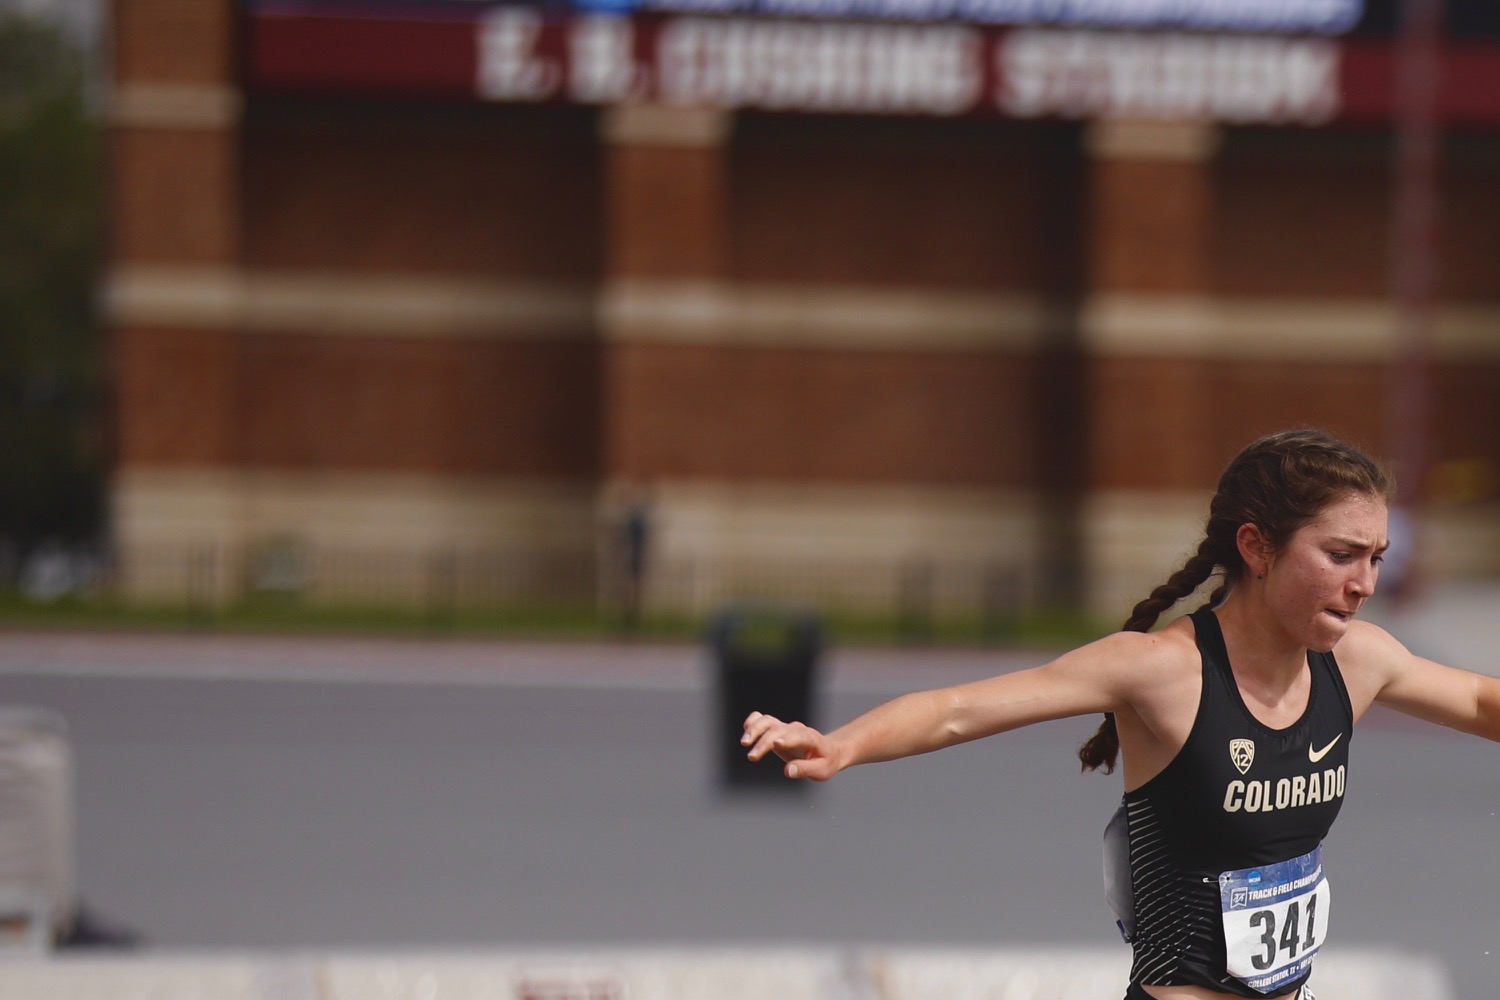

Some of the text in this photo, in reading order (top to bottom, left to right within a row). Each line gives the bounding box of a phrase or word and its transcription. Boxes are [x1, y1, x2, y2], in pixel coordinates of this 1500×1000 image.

[1231, 740, 1254, 761] PAC
[1237, 753, 1250, 767] 12
[1222, 764, 1346, 813] COLORADO
[1248, 887, 1272, 901] TRACK
[1249, 893, 1317, 970] 341
